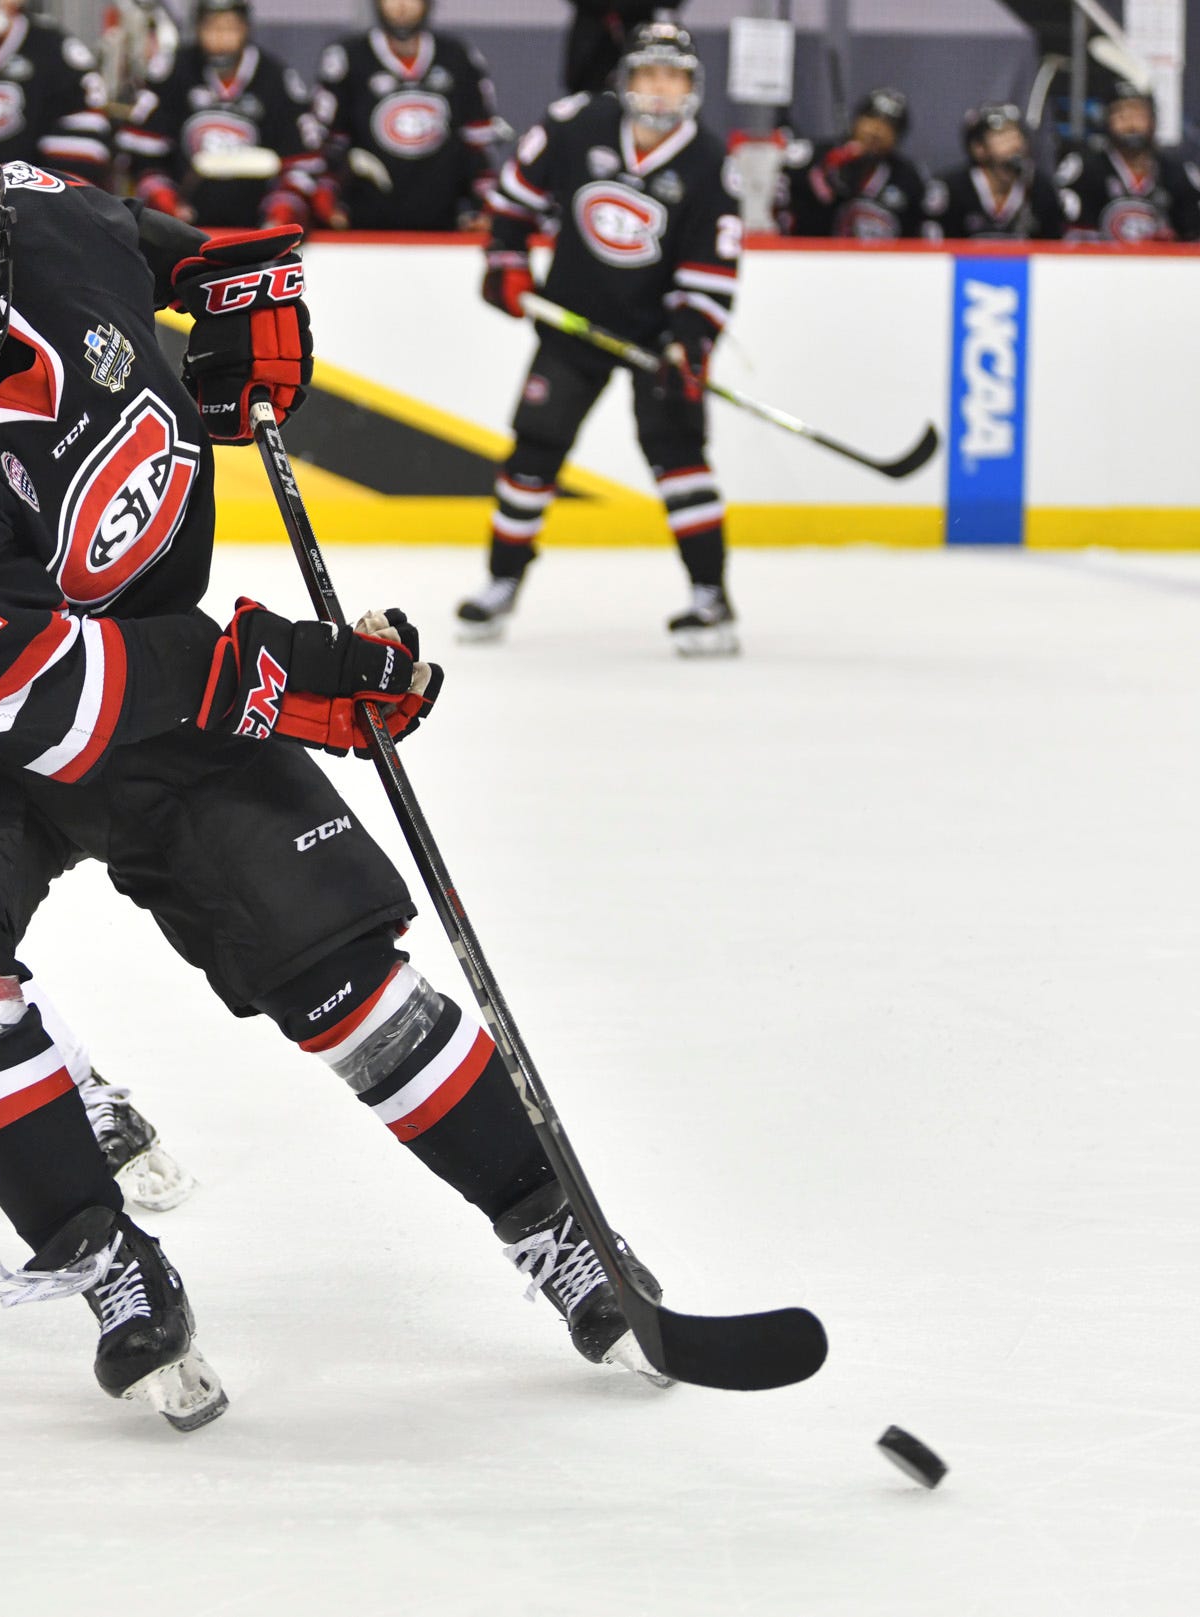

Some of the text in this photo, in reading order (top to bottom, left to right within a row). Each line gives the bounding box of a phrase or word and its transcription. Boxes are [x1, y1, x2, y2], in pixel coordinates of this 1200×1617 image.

[200, 262, 304, 315] CC
[963, 277, 1019, 461] NCAA
[202, 402, 236, 413] CCM
[51, 411, 90, 460] CCM
[266, 427, 300, 499] CCM
[310, 548, 325, 573] OKABE
[378, 645, 395, 690] CCM
[293, 815, 352, 852] CCM
[307, 981, 353, 1021] CCM
